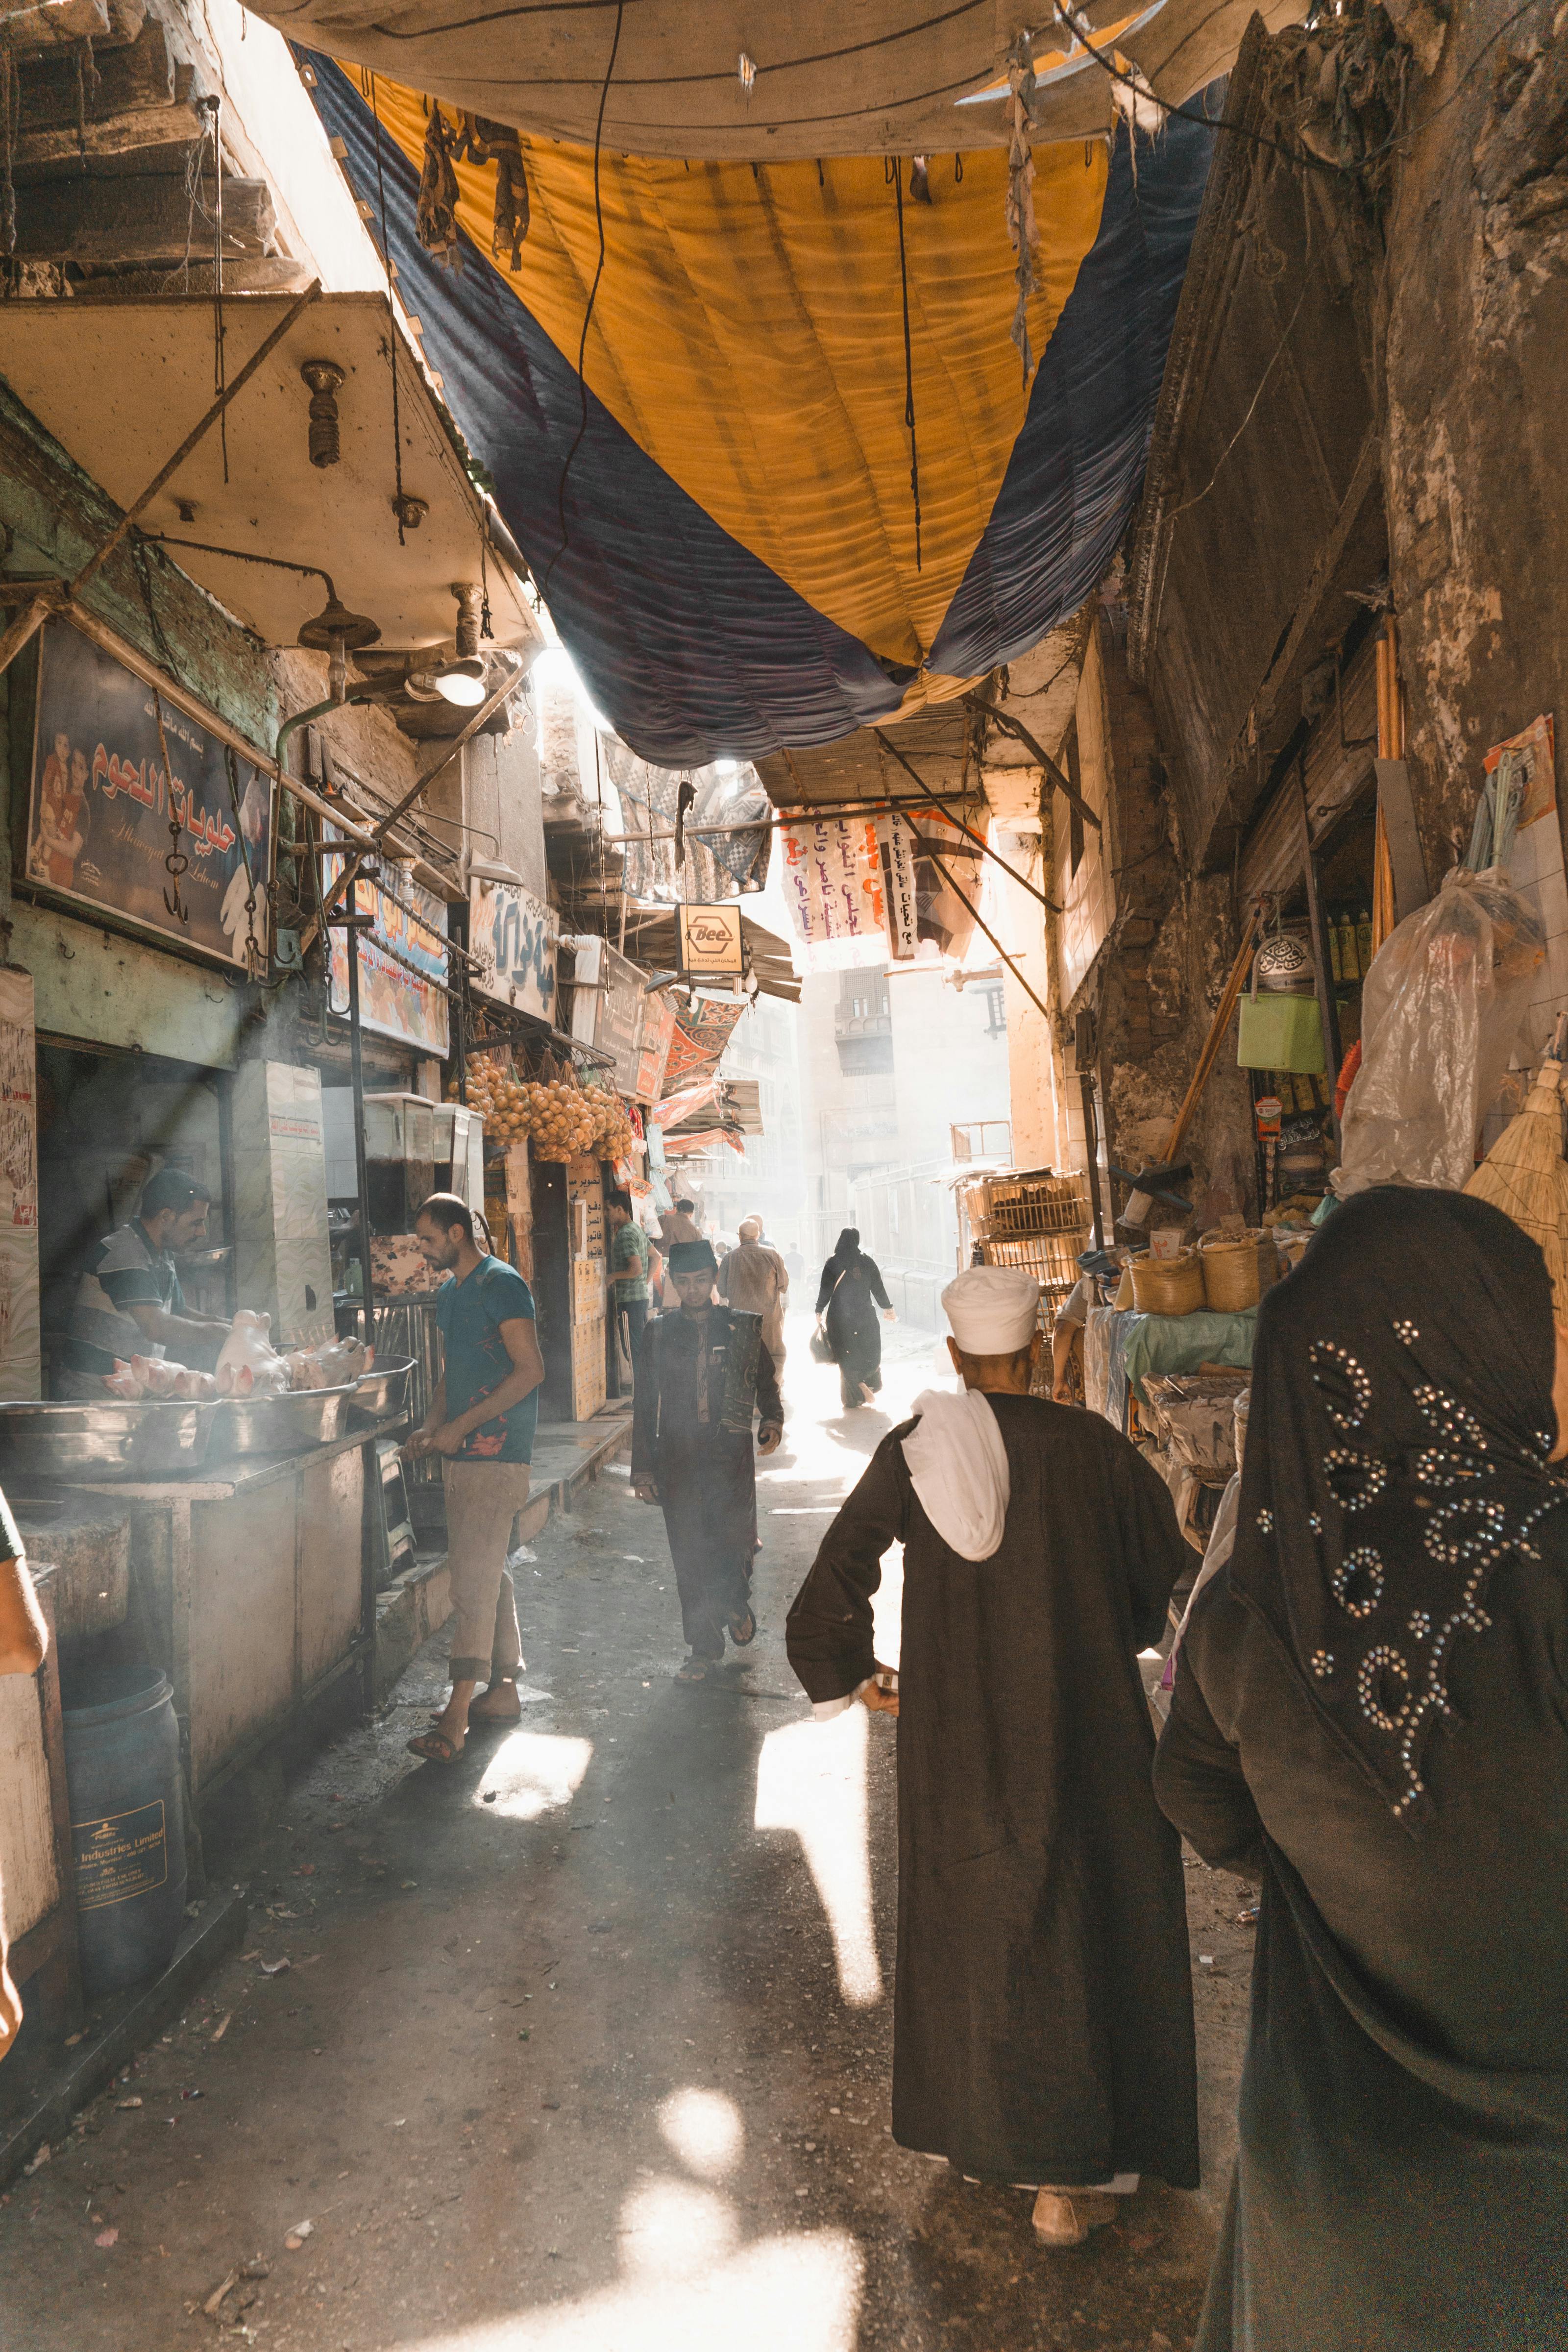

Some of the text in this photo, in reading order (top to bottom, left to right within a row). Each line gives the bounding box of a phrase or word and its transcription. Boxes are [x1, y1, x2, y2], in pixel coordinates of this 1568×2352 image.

[177, 726, 189, 743] الله
[190, 737, 204, 759] بسم
[92, 742, 237, 858] حلويات اللحوم
[782, 837, 808, 866] رقم
[815, 856, 836, 896] ناصر
[900, 892, 914, 927] تحيات
[688, 924, 734, 941] Bee
[902, 931, 912, 944] مع
[579, 1176, 600, 1187] تصوير
[588, 1201, 601, 1214] دفع
[587, 1230, 602, 1243] فاتور
[587, 1247, 602, 1257] فاتور
[81, 1828, 164, 1862] Industries Limited
